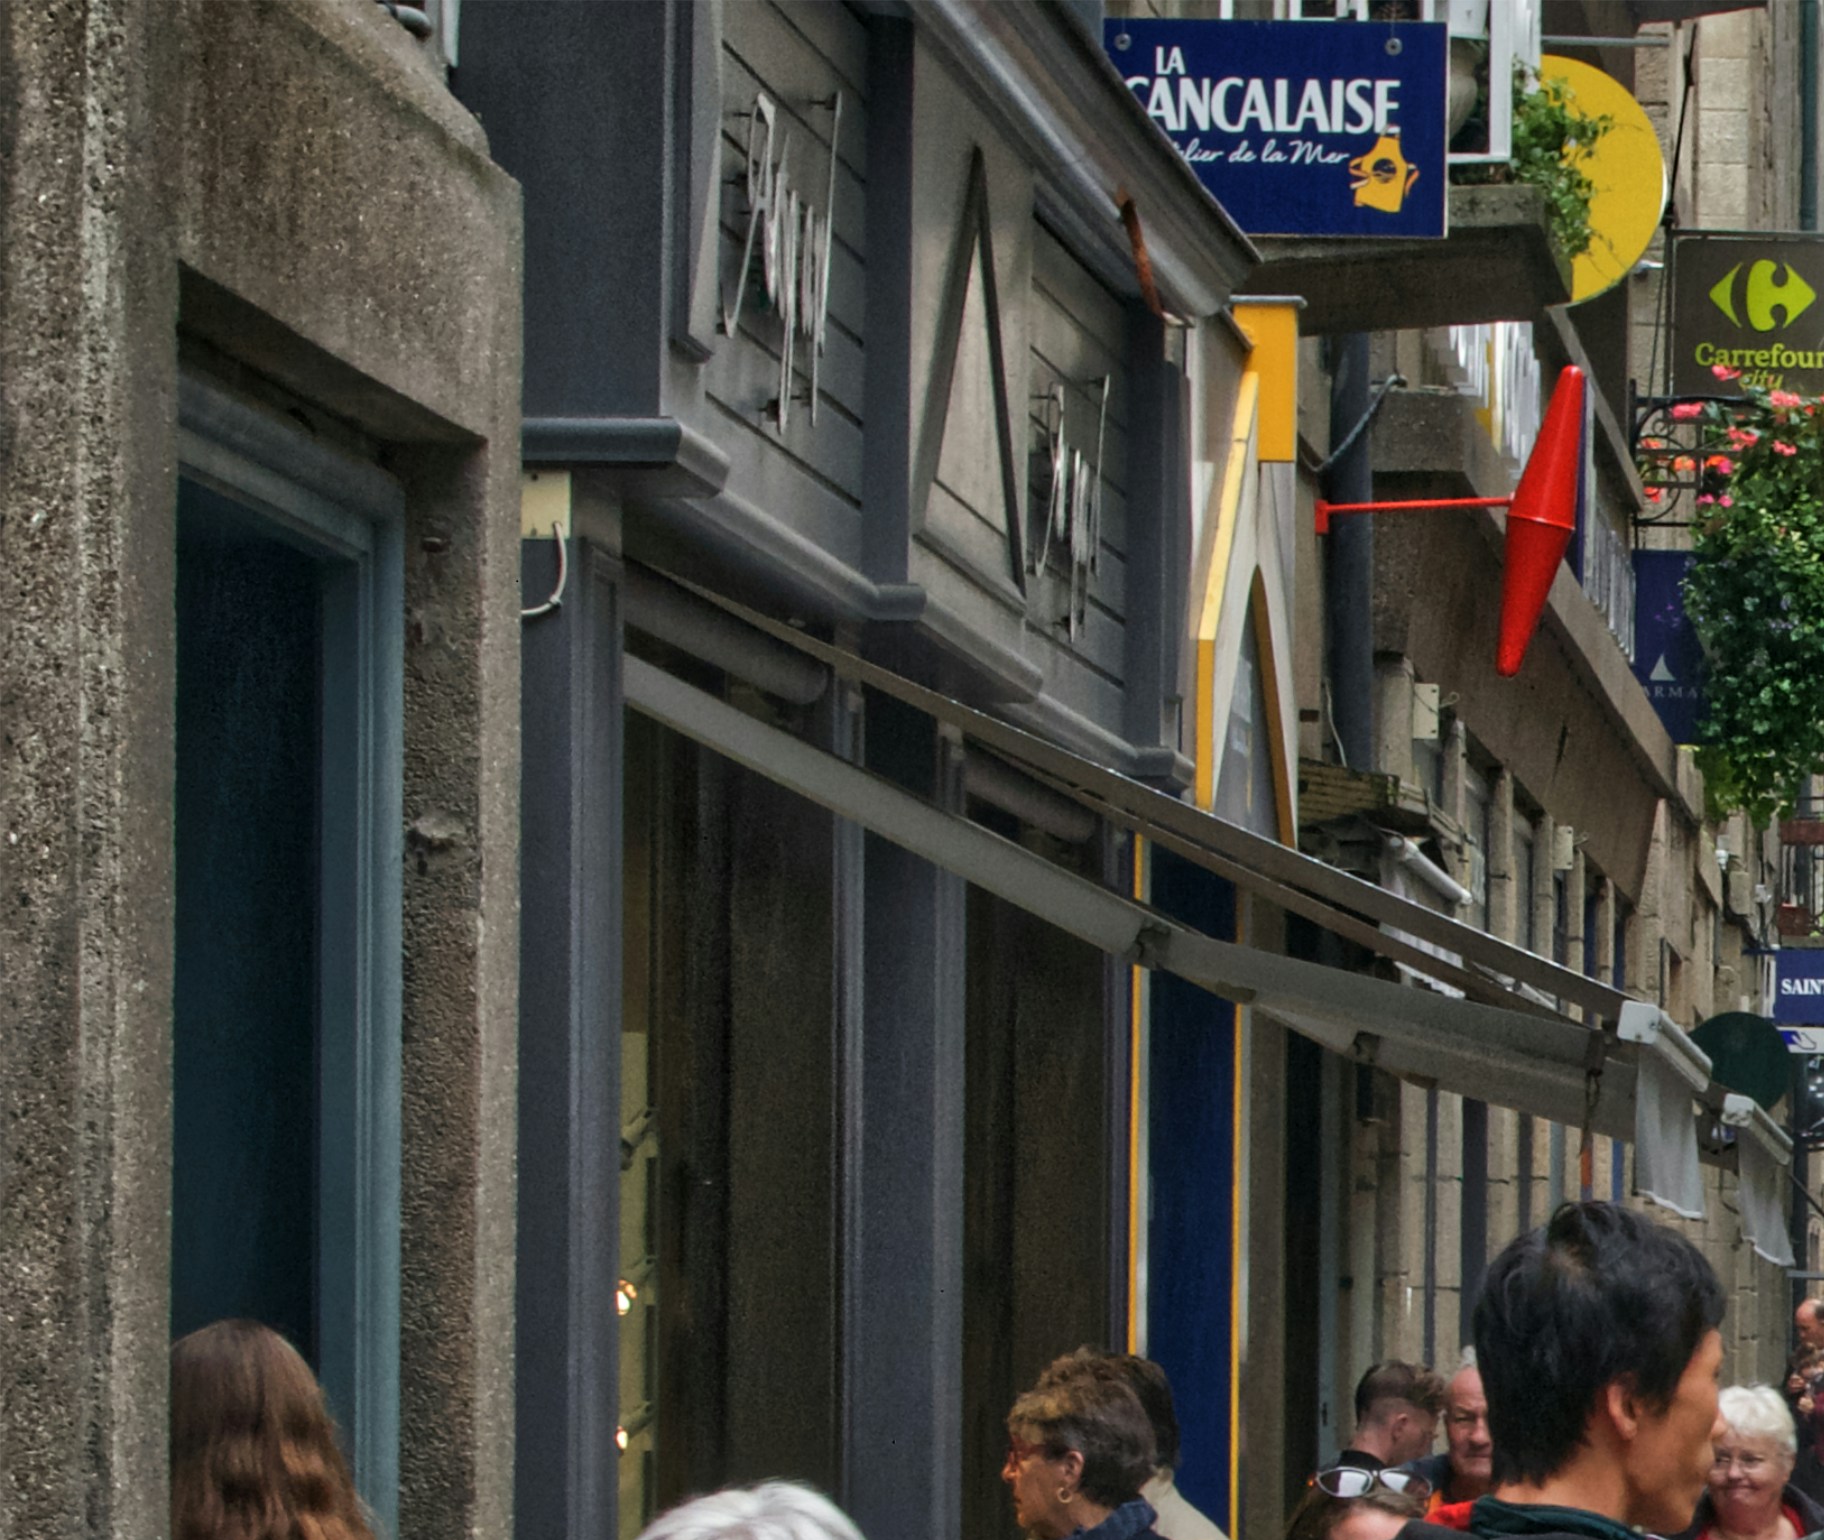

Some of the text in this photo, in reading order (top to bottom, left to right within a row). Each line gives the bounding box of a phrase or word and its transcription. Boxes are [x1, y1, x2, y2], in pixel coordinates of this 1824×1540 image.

[1156, 46, 1185, 75] LA
[1228, 140, 1256, 163] de
[1261, 138, 1287, 163] la
[1289, 140, 1350, 165] Mer
[1738, 369, 1784, 392] city
